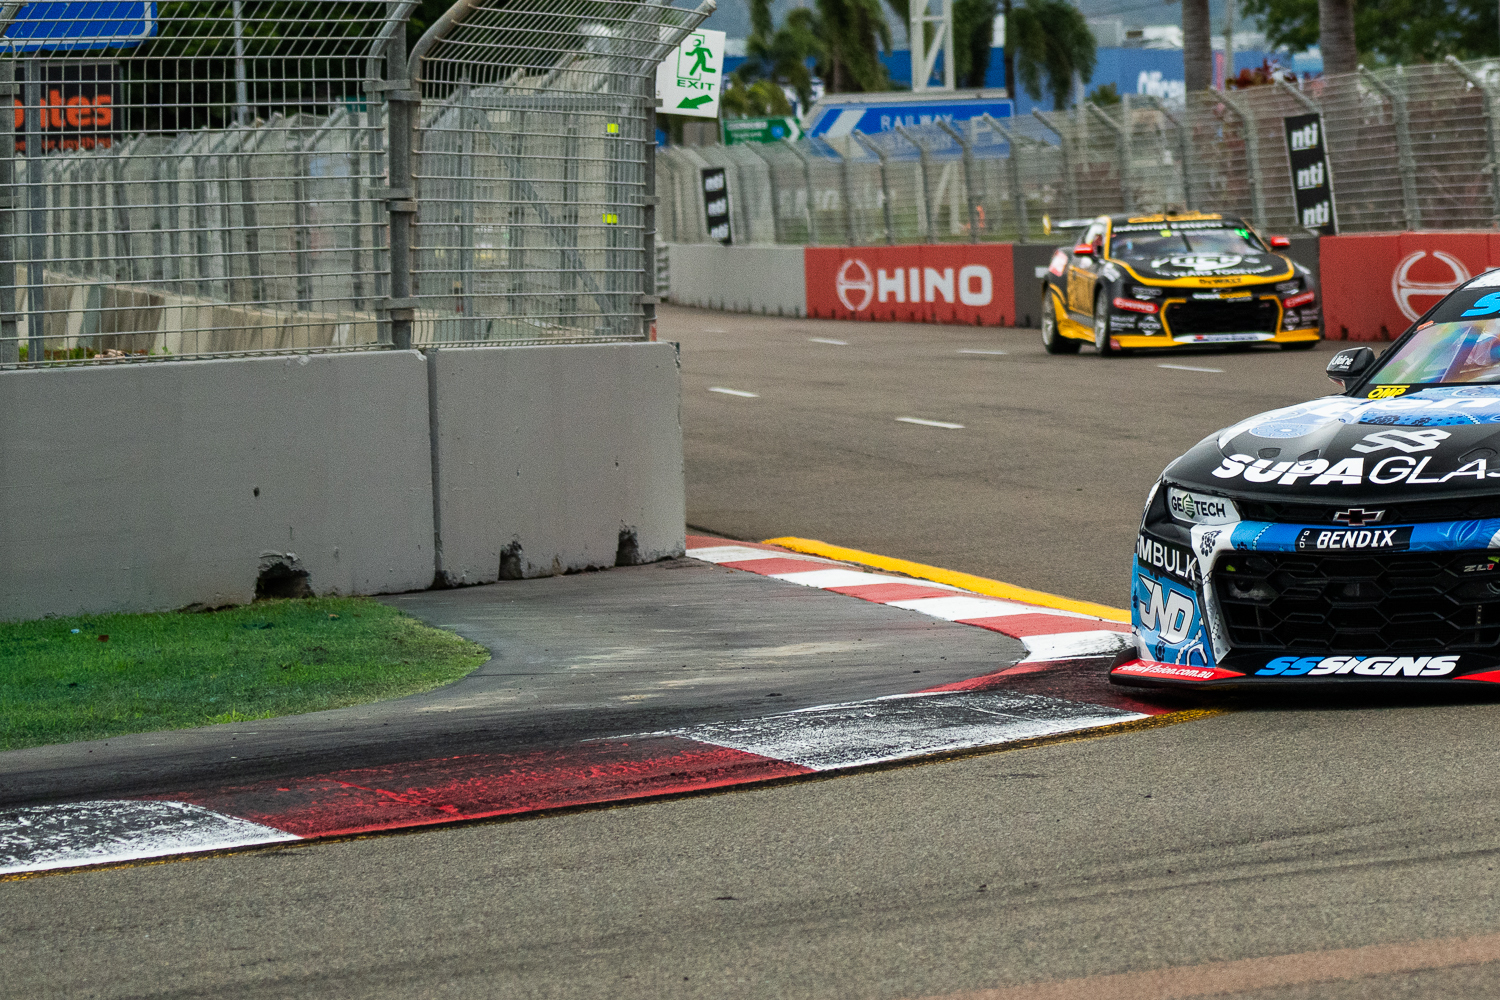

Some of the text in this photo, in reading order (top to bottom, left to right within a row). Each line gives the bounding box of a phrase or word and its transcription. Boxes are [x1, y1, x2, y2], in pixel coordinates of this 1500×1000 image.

[676, 79, 715, 91] EXIT
[1291, 123, 1319, 148] nti
[1297, 162, 1324, 187] nti
[1303, 201, 1329, 226] nti
[877, 265, 993, 306] HINO
[1368, 387, 1407, 399] OMP
[1317, 530, 1397, 549] BENDIX
[1137, 534, 1198, 581] MBULK
